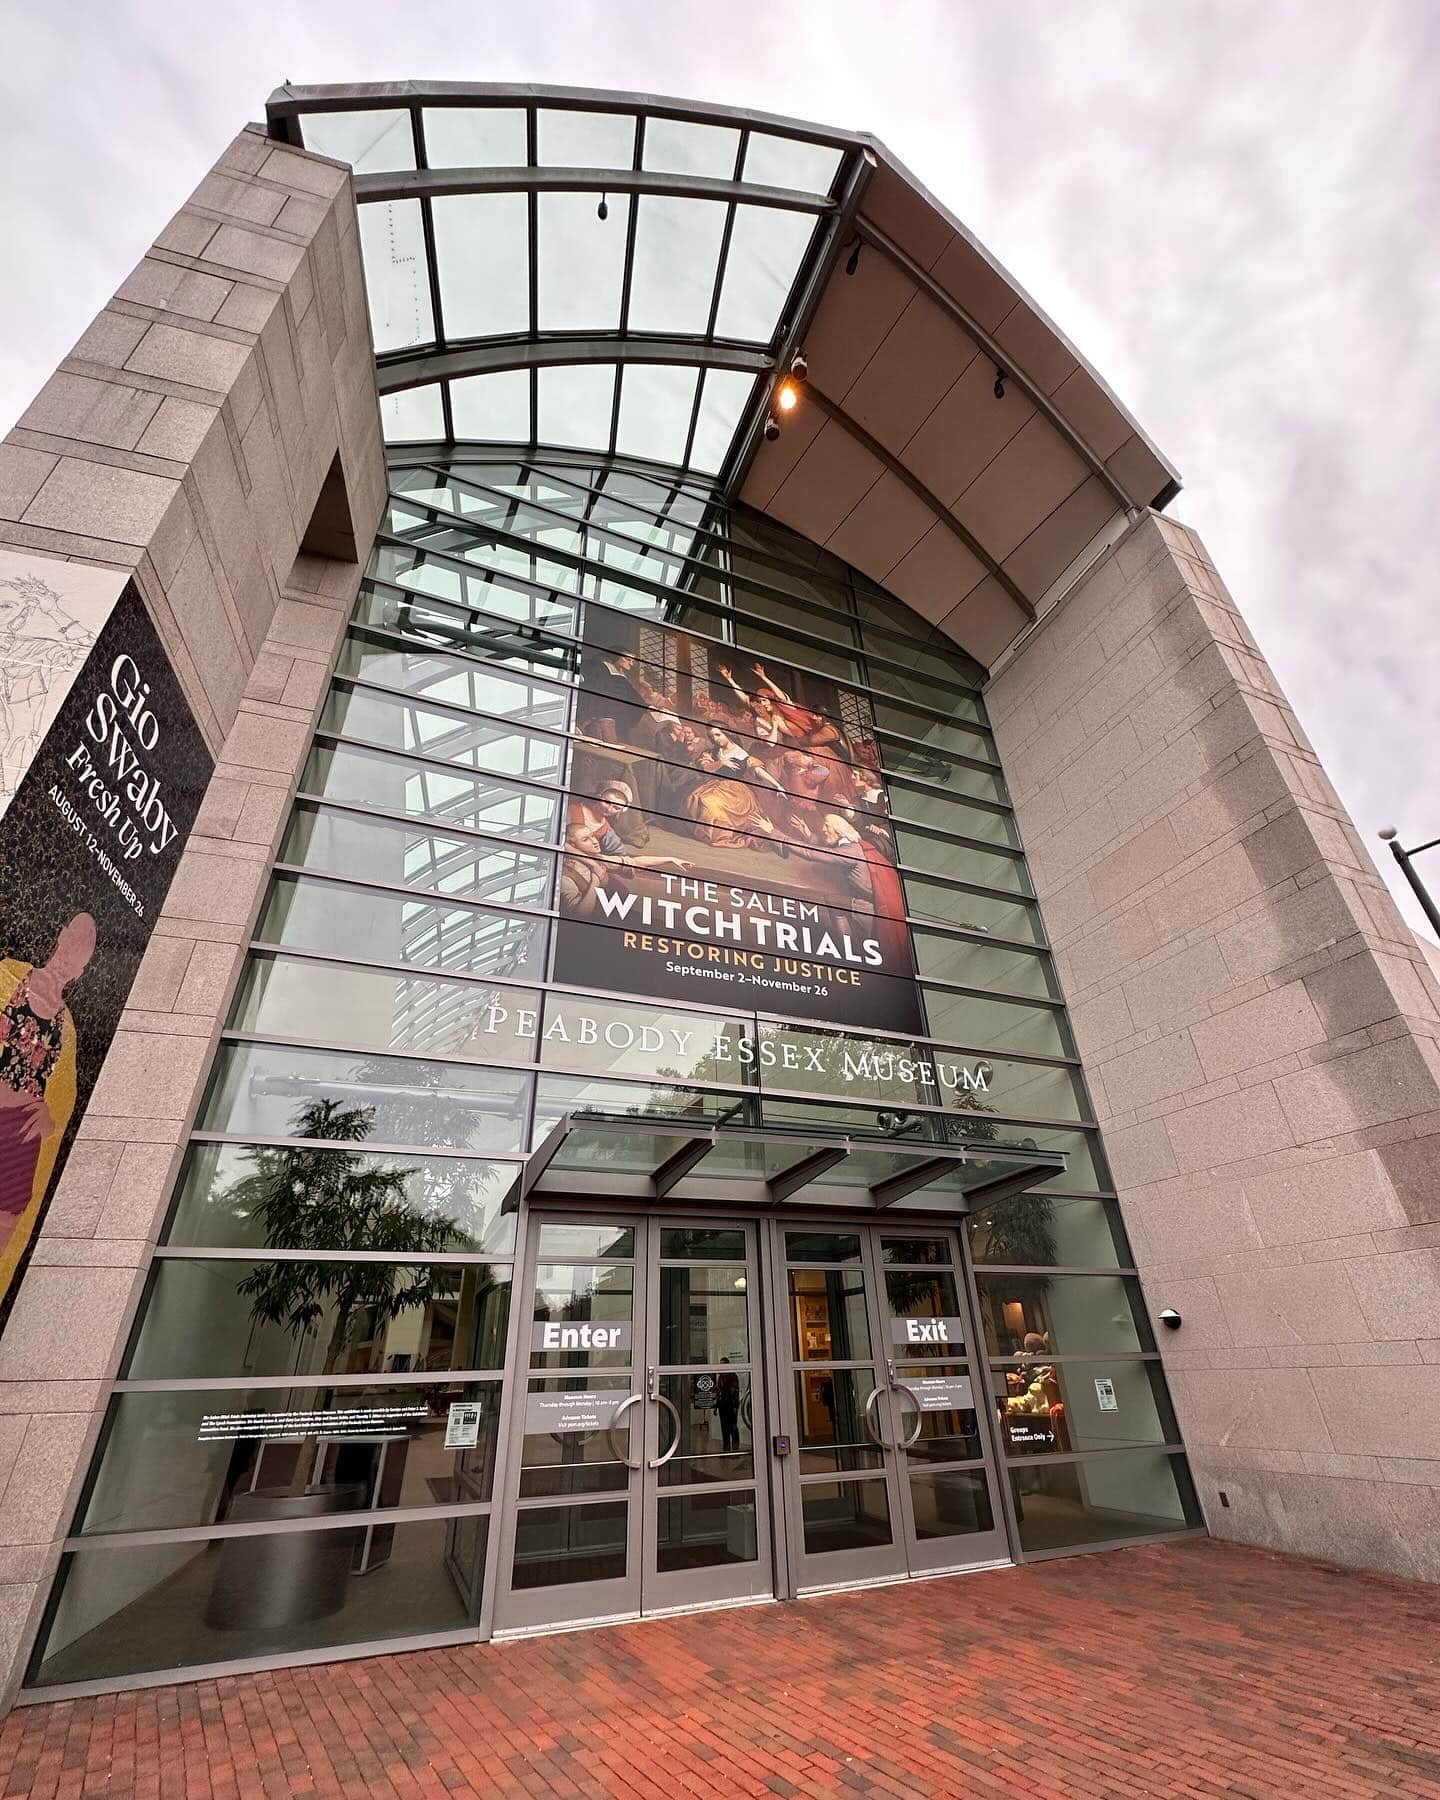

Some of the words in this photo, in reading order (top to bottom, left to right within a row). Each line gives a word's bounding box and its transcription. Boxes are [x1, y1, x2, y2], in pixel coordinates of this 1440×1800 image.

[111, 654, 159, 751] Gio
[65, 741, 121, 828] Fresh
[119, 816, 143, 859] Up
[86, 693, 179, 854] Swaby
[48, 784, 88, 837] AUGUST
[134, 901, 145, 917] 26
[594, 887, 742, 941] WITCH
[749, 916, 883, 966] TRIALS
[660, 874, 719, 903] THE
[729, 888, 819, 923] SALEM
[623, 932, 765, 970] RESTORING
[774, 958, 861, 986] JUSTICE
[666, 961, 735, 981] September
[814, 985, 829, 997] 26
[484, 1005, 694, 1056] PEABODY
[714, 1035, 827, 1073] ESSEX
[842, 1051, 990, 1092] MUSEUM
[543, 1322, 621, 1348] Enter
[906, 1318, 949, 1341] Exit
[1033, 1432, 1046, 1441] Only
